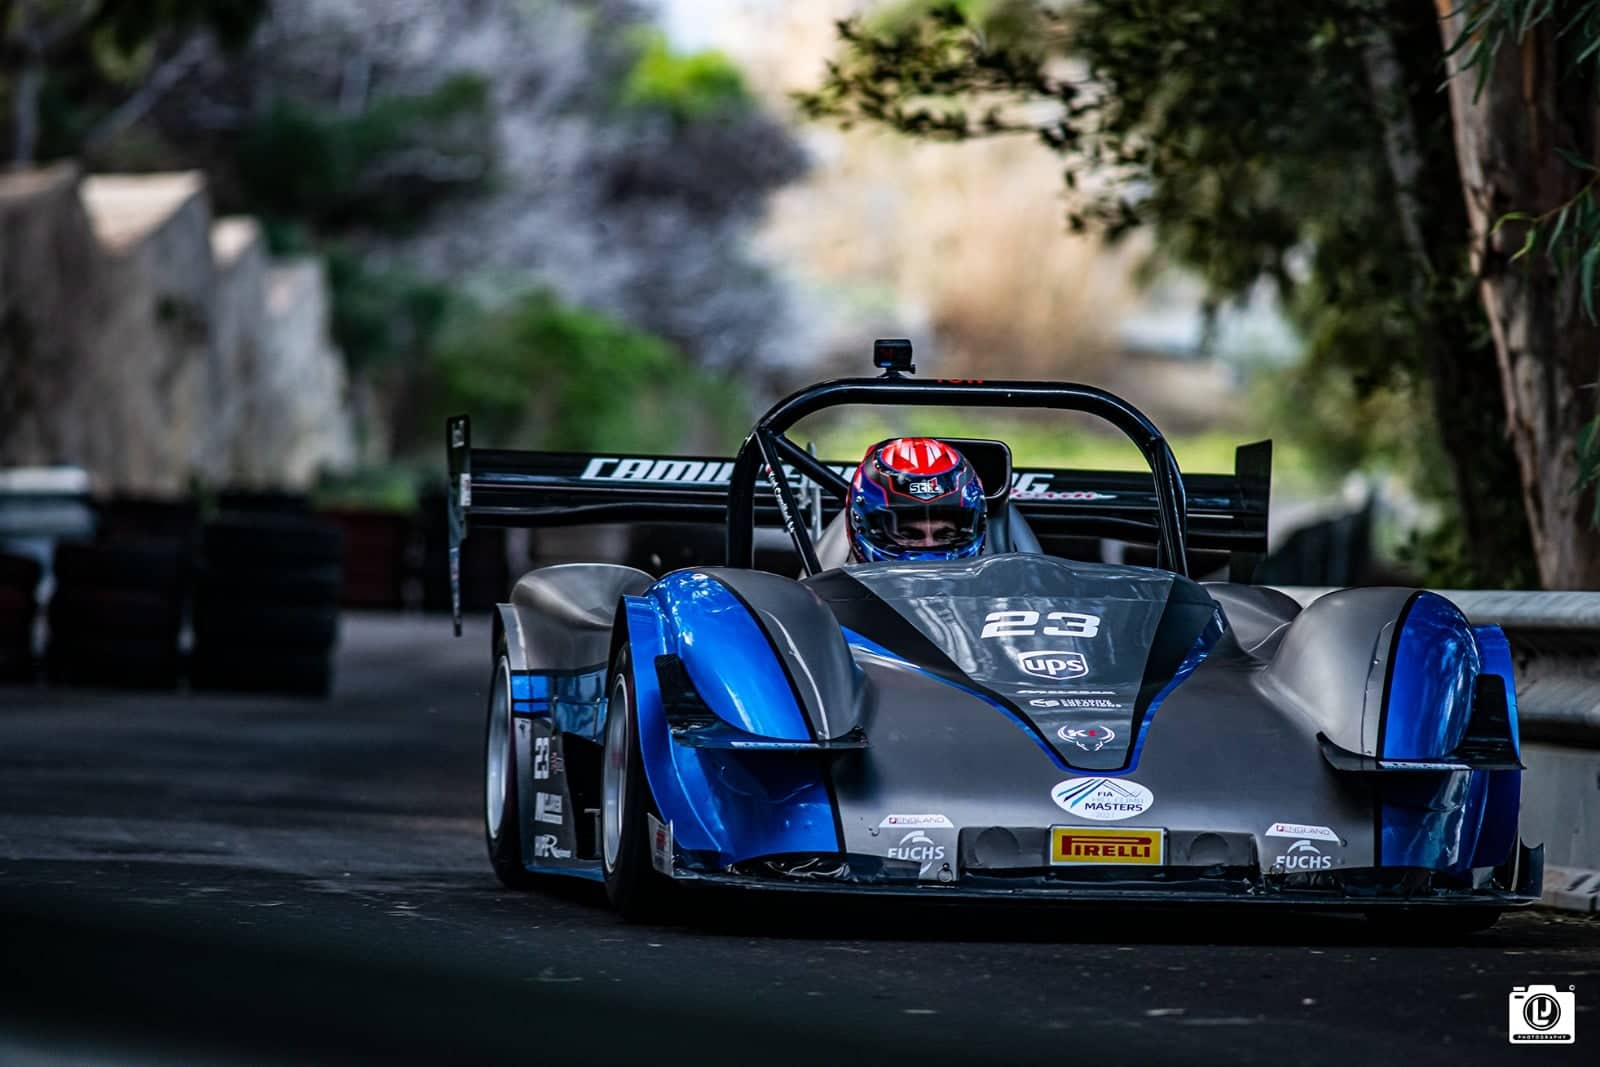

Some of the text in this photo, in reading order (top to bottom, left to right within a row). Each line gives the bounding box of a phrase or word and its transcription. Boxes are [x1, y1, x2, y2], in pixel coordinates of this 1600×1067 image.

[980, 610, 1101, 638] 23
[1024, 658, 1085, 676] ups
[1084, 802, 1143, 812] MASTERS
[887, 845, 945, 860] FUCHS
[1061, 835, 1152, 858] PIRELLI
[1275, 855, 1332, 869] FUCHS
